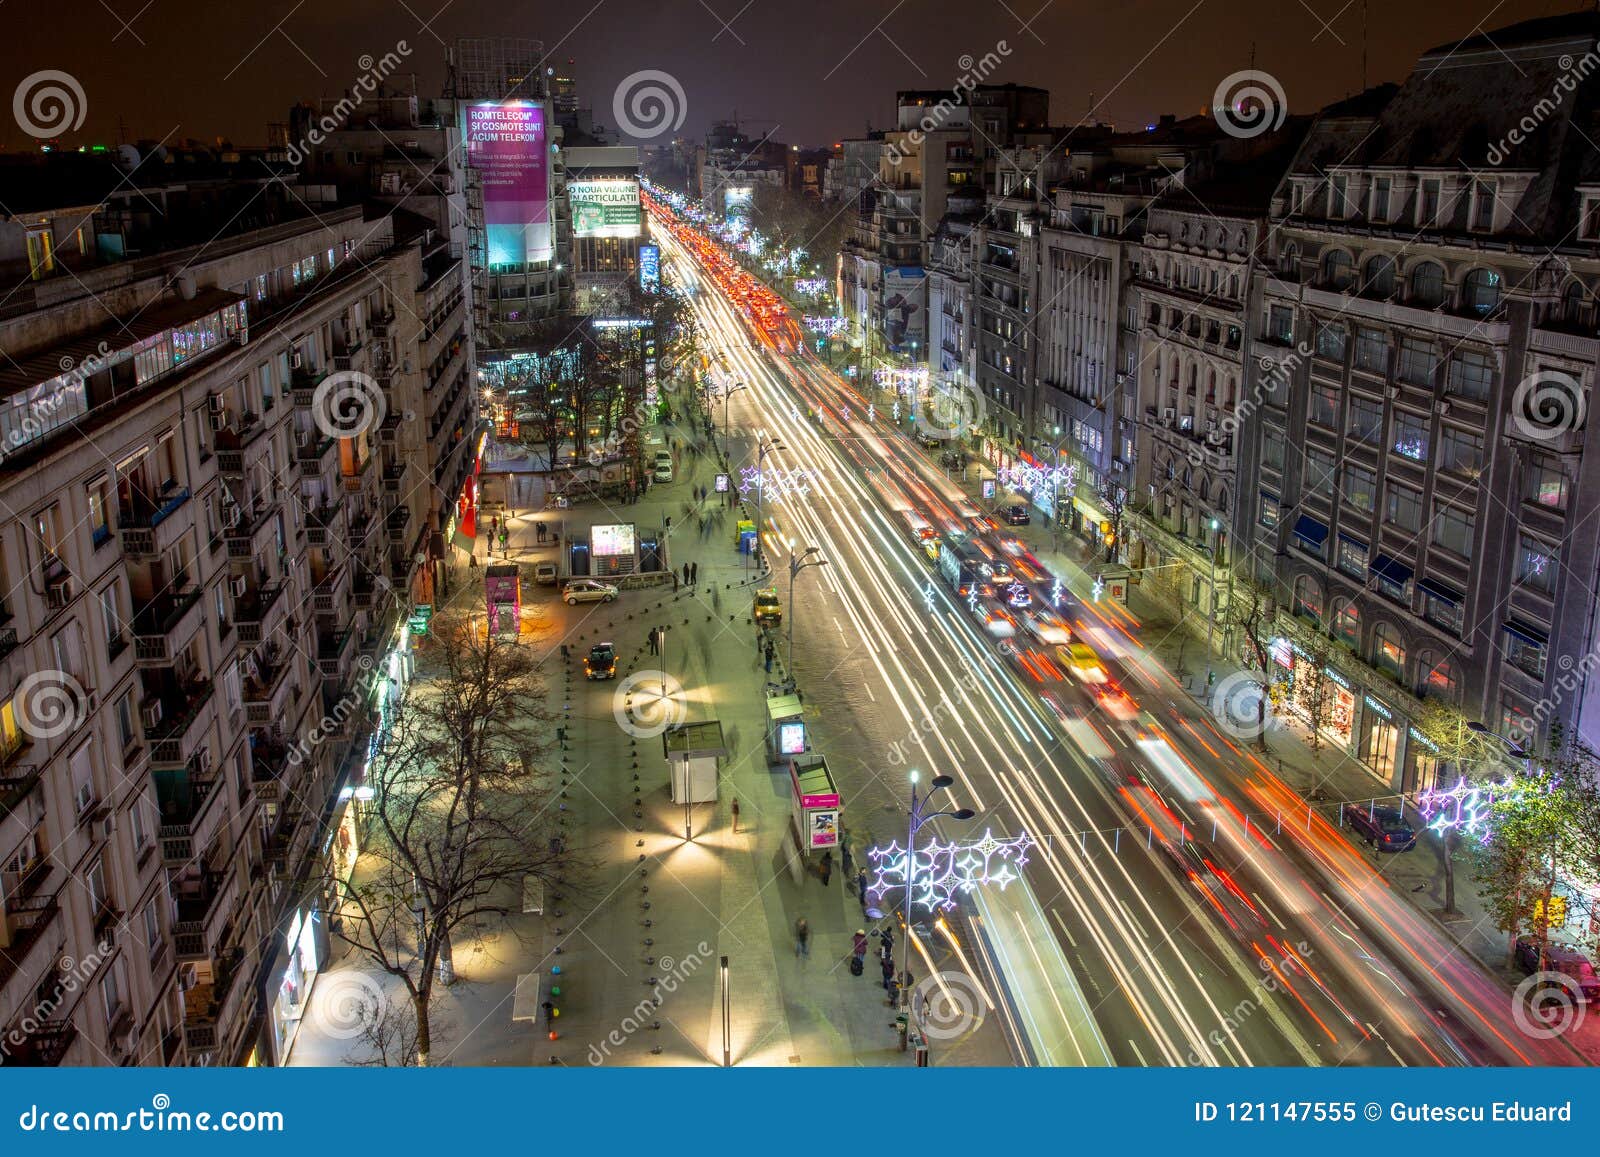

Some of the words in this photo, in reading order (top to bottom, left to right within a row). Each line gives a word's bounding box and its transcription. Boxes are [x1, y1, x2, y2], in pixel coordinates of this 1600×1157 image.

[482, 122, 523, 131] COSMOTE
[524, 123, 541, 131] SUNT
[472, 132, 498, 141] ACUM
[500, 133, 535, 142] TELEKOM
